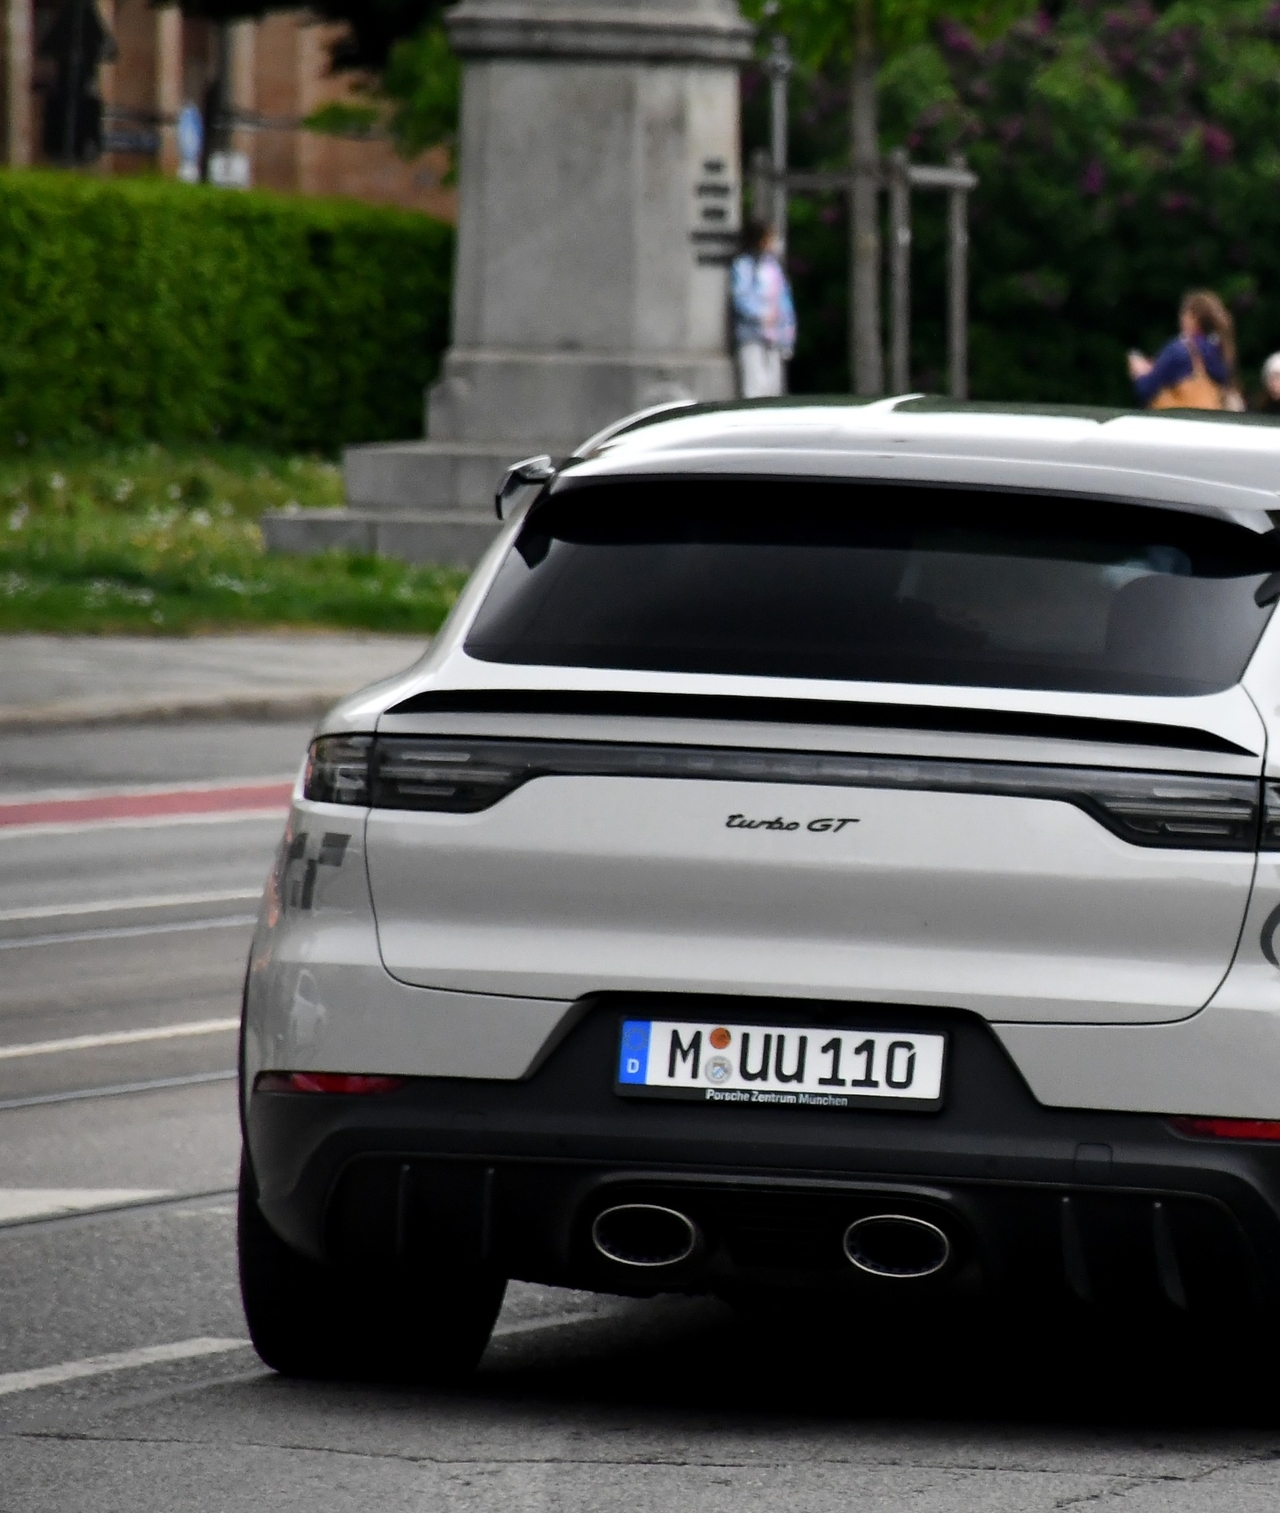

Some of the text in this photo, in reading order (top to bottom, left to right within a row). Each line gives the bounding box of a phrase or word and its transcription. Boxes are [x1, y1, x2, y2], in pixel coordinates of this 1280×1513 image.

[725, 814, 861, 833] turbo GT
[627, 1058, 639, 1074] D
[668, 1029, 915, 1090] M UU 110
[705, 1089, 848, 1107] Porsche Zentrum München
